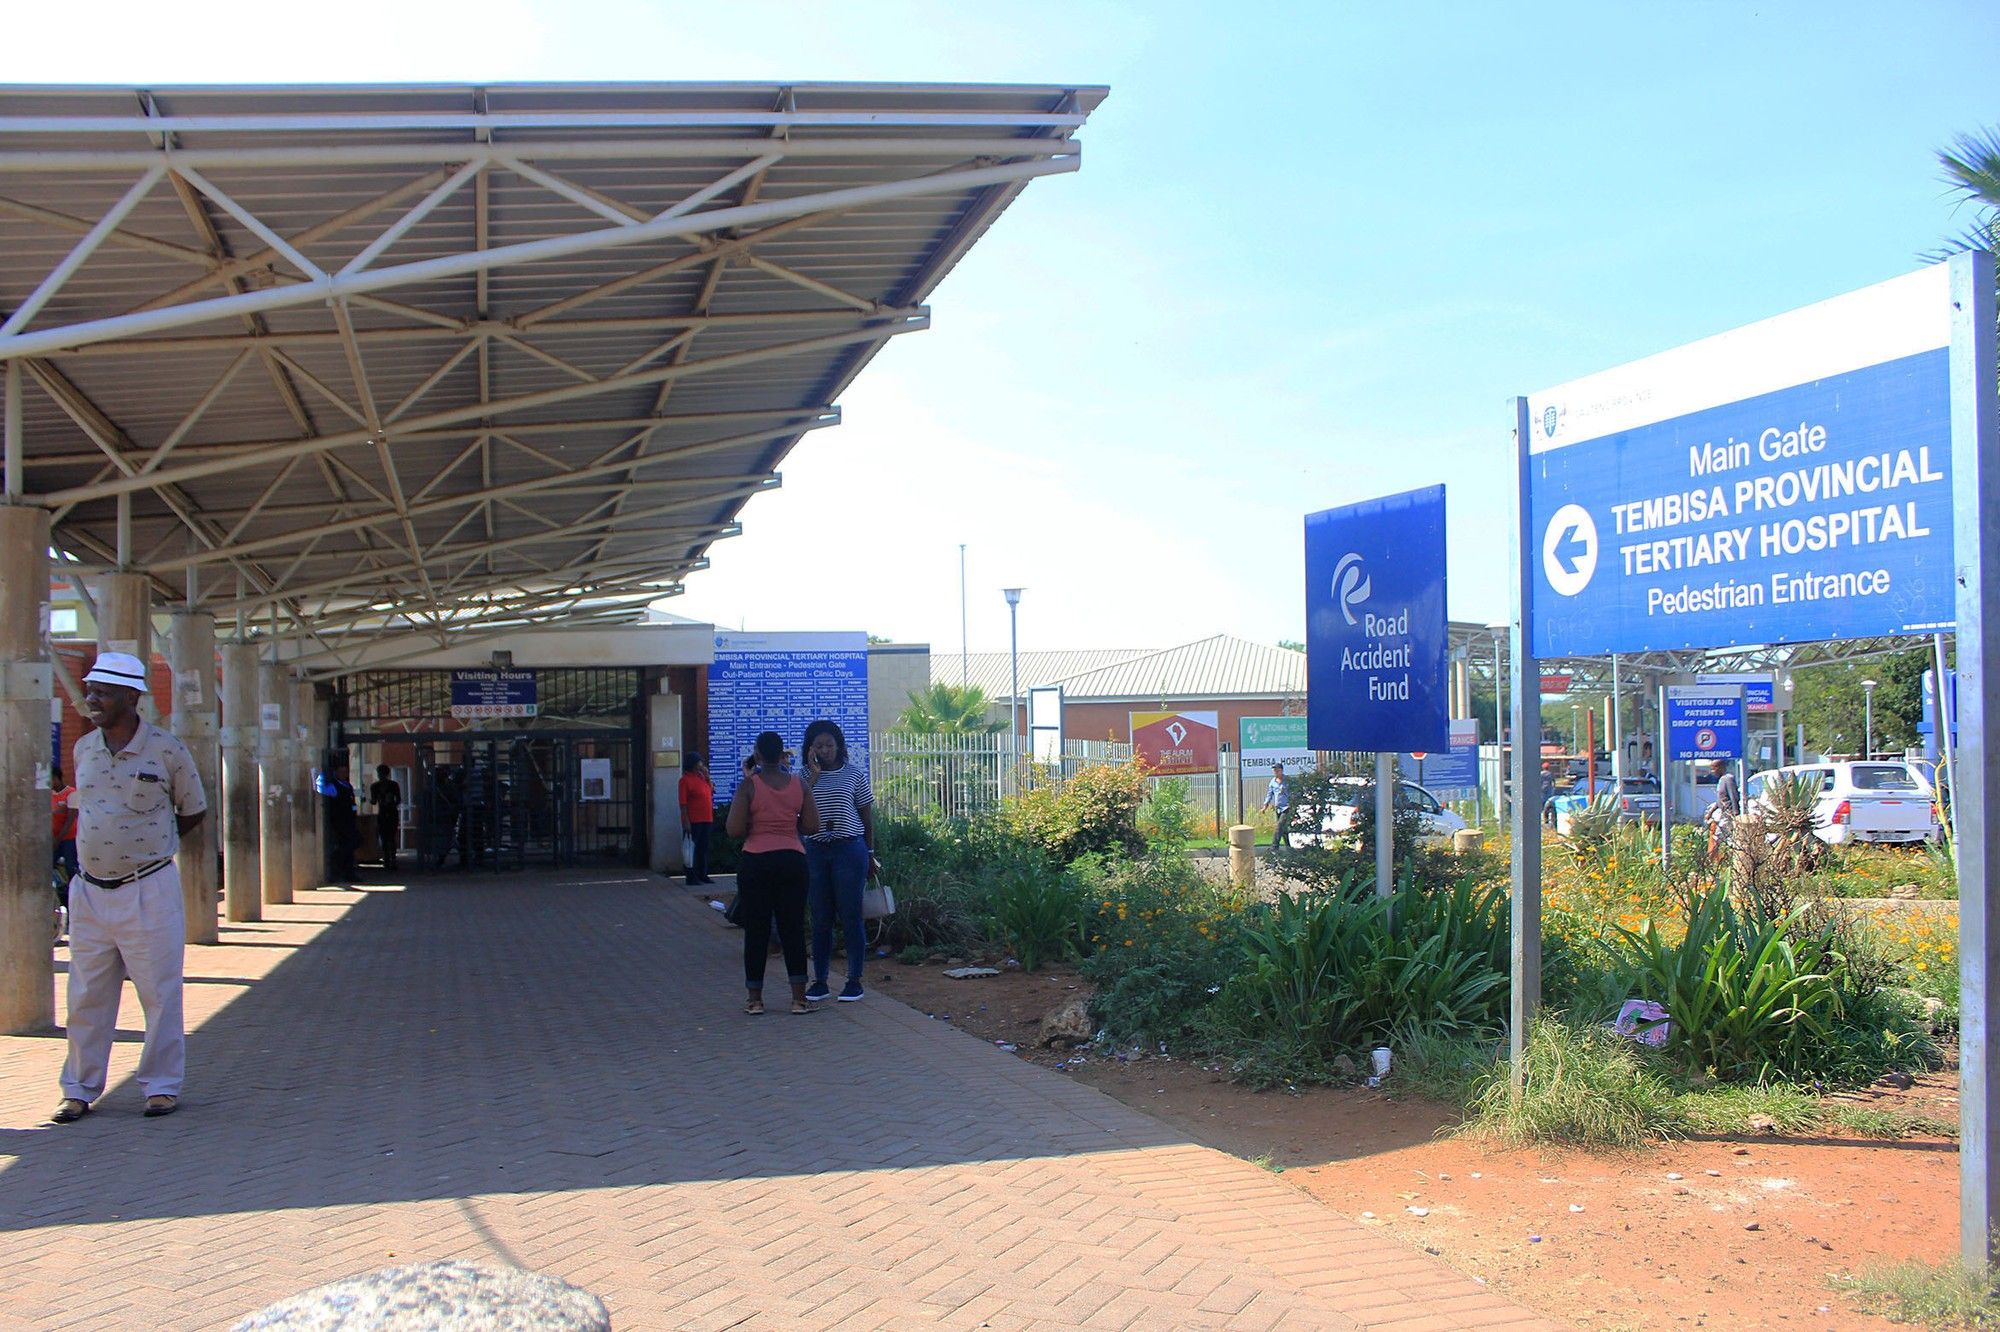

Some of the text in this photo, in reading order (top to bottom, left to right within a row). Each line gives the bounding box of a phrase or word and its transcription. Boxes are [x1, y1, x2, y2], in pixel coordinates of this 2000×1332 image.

[1689, 421, 1827, 477] Main Gate
[1611, 446, 1943, 535] TEMBISA PROVINCIAL
[1620, 501, 1930, 576] TERTIARY HOSPITAL
[1648, 579, 1764, 616] Pedestrian
[1771, 568, 1891, 604] Entrance
[1364, 607, 1409, 639] Road
[714, 652, 866, 661] EMBISA PROVINCIAL TERTIARY HOSPITAL
[1340, 643, 1411, 672] Accident
[729, 661, 748, 669] Main
[749, 661, 782, 669] Entrance
[788, 660, 827, 669] Pedestrian
[828, 660, 847, 669] Gate
[457, 671, 533, 682] Visiting Hours
[764, 670, 808, 679] Department
[813, 669, 834, 678] Clinic
[834, 669, 854, 679] Days
[1368, 673, 1410, 702] Fund
[1675, 699, 1715, 707] VISITORS
[1684, 709, 1725, 717] PATIENTS
[1672, 720, 1696, 728] DROP
[1714, 719, 1738, 727] ZONE
[1680, 750, 1732, 759] NO PARKING
[1241, 756, 1316, 768] TEMBISA HOSPITAL
